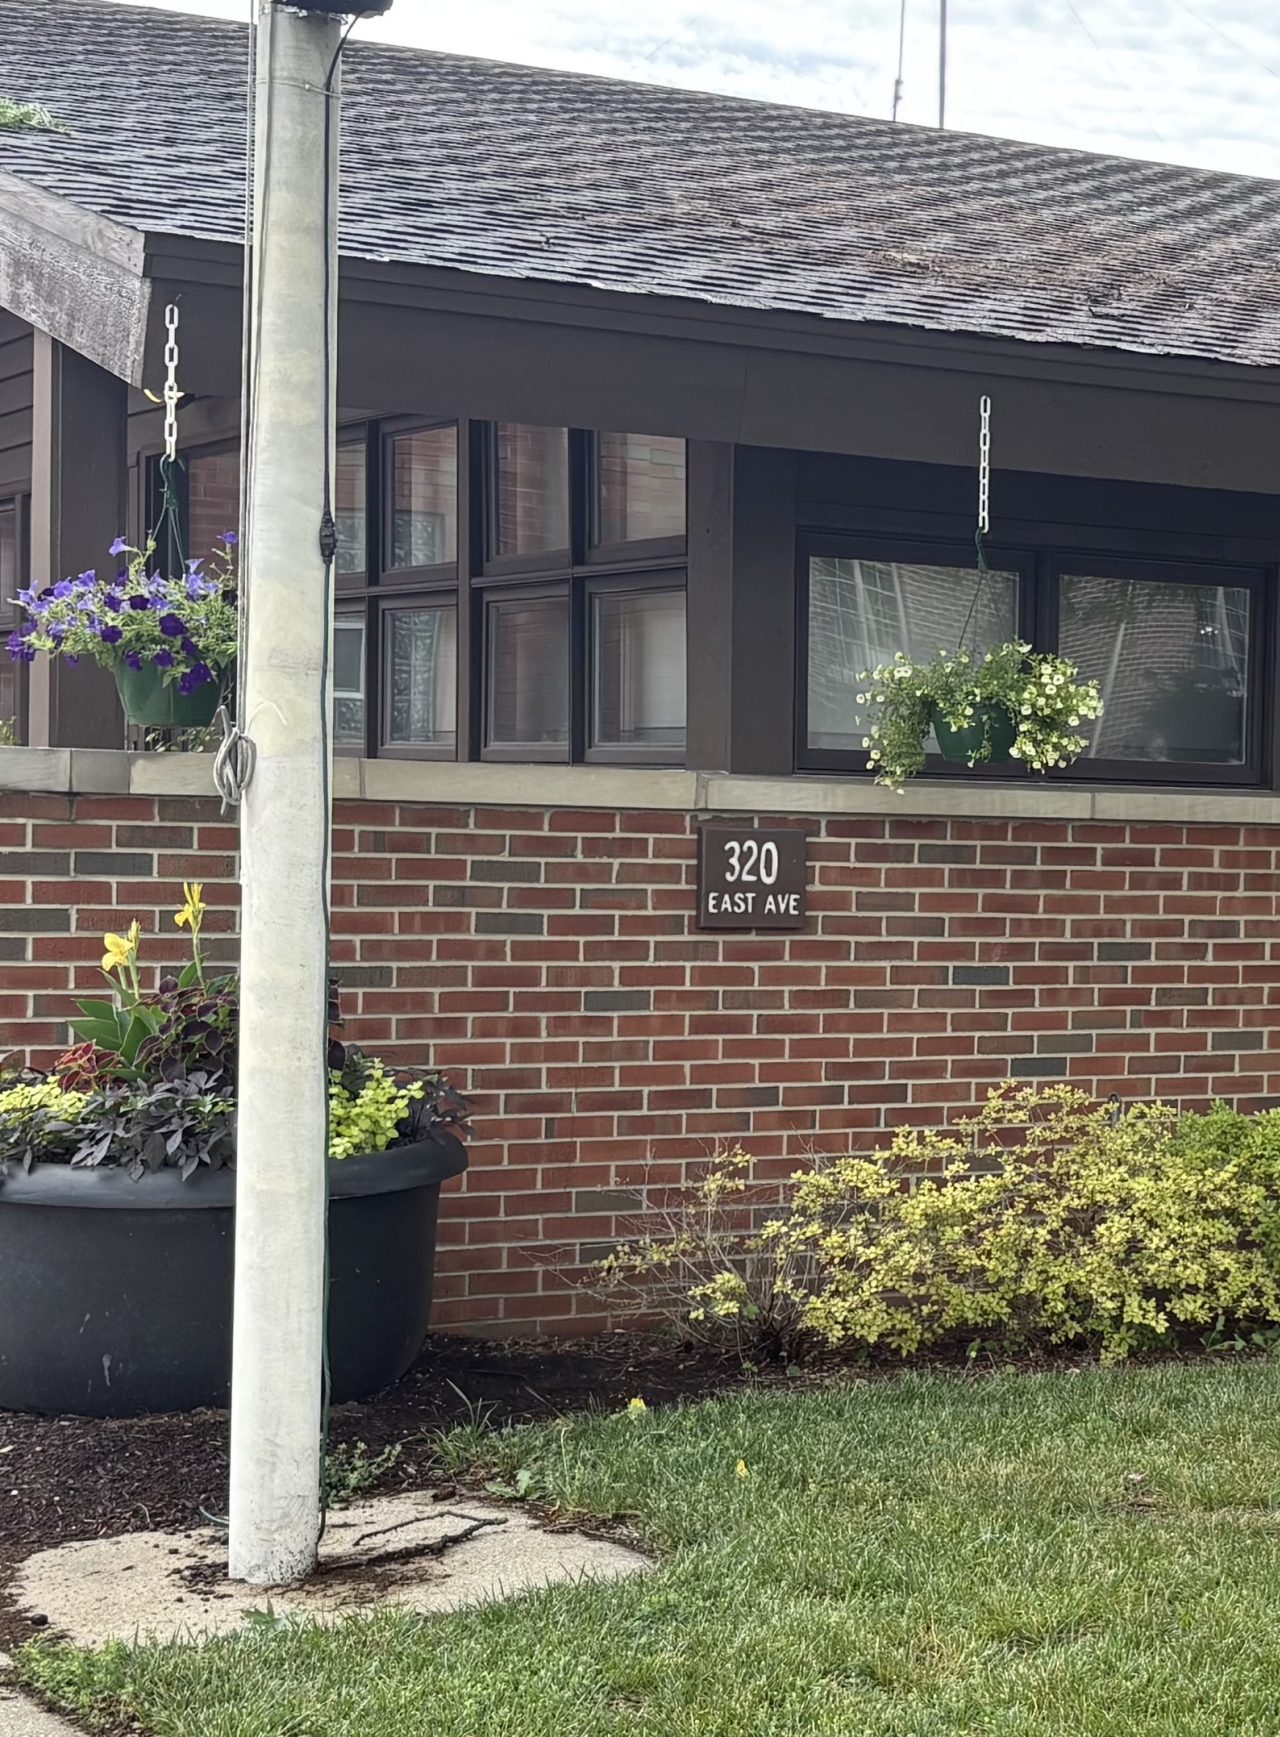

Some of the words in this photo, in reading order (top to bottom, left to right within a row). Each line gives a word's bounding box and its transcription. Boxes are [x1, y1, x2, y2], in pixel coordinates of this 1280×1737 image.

[724, 839, 778, 885] 320
[708, 892, 756, 913] EAST
[764, 893, 800, 914] AVE
